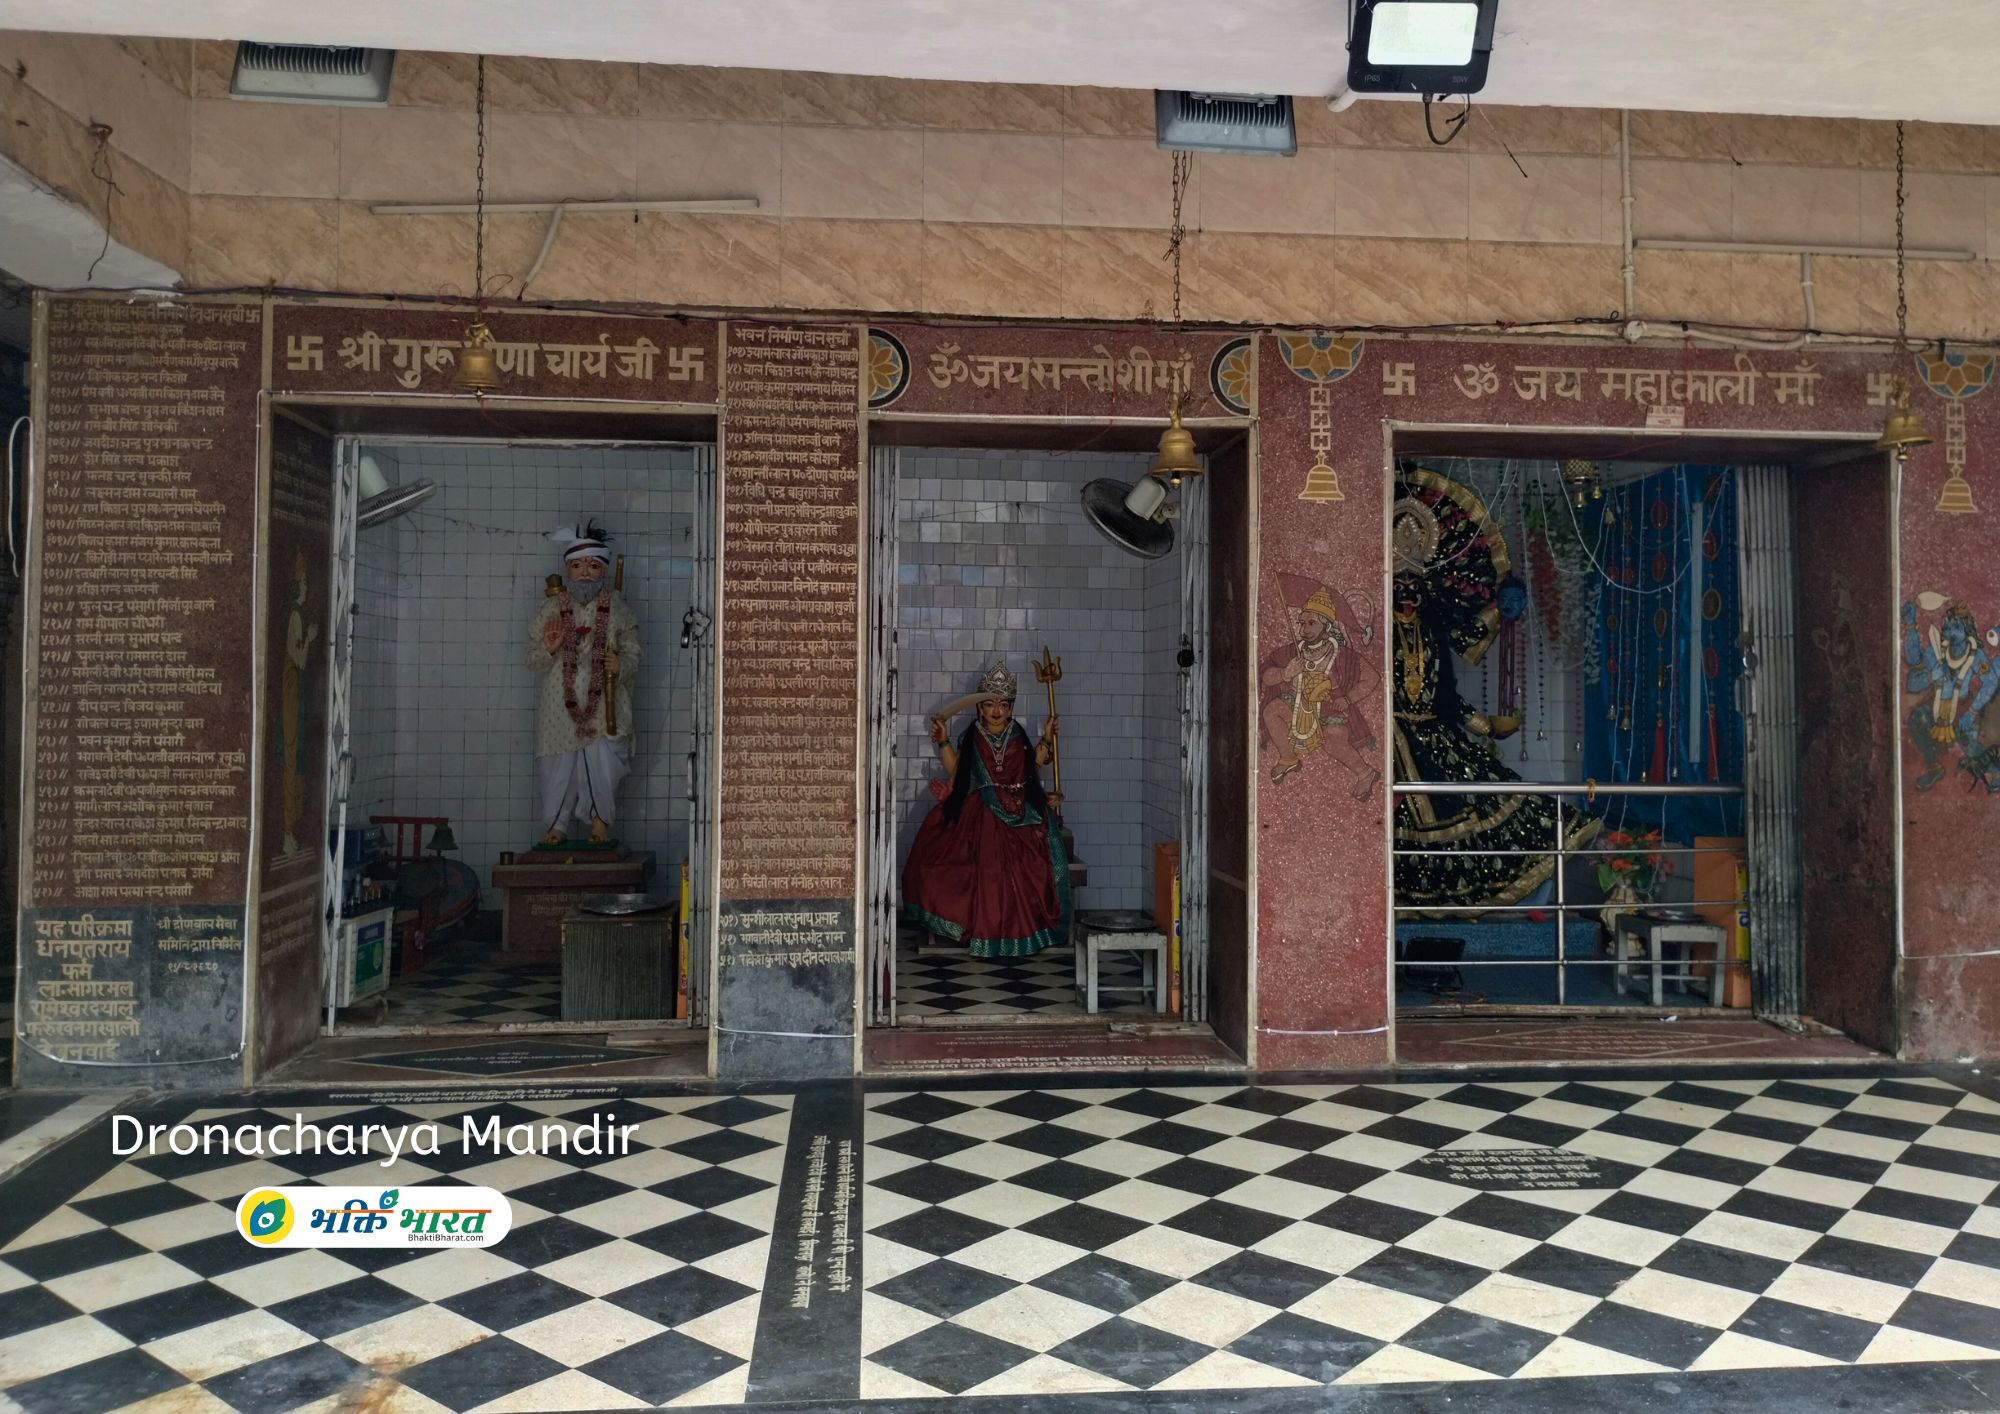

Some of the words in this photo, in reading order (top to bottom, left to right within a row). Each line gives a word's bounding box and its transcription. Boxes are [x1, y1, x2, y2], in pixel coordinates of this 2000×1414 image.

[337, 330, 386, 372] श्री
[614, 337, 661, 380] जी
[968, 355, 1032, 390] जय
[1453, 362, 1500, 400] ॐ
[1513, 365, 1589, 401] जय
[1596, 353, 1762, 408] महाकाली
[1766, 360, 1822, 406] माँ
[36, 920, 66, 938] यह
[68, 914, 133, 937] परिक्रमा
[61, 958, 94, 980] फर्म
